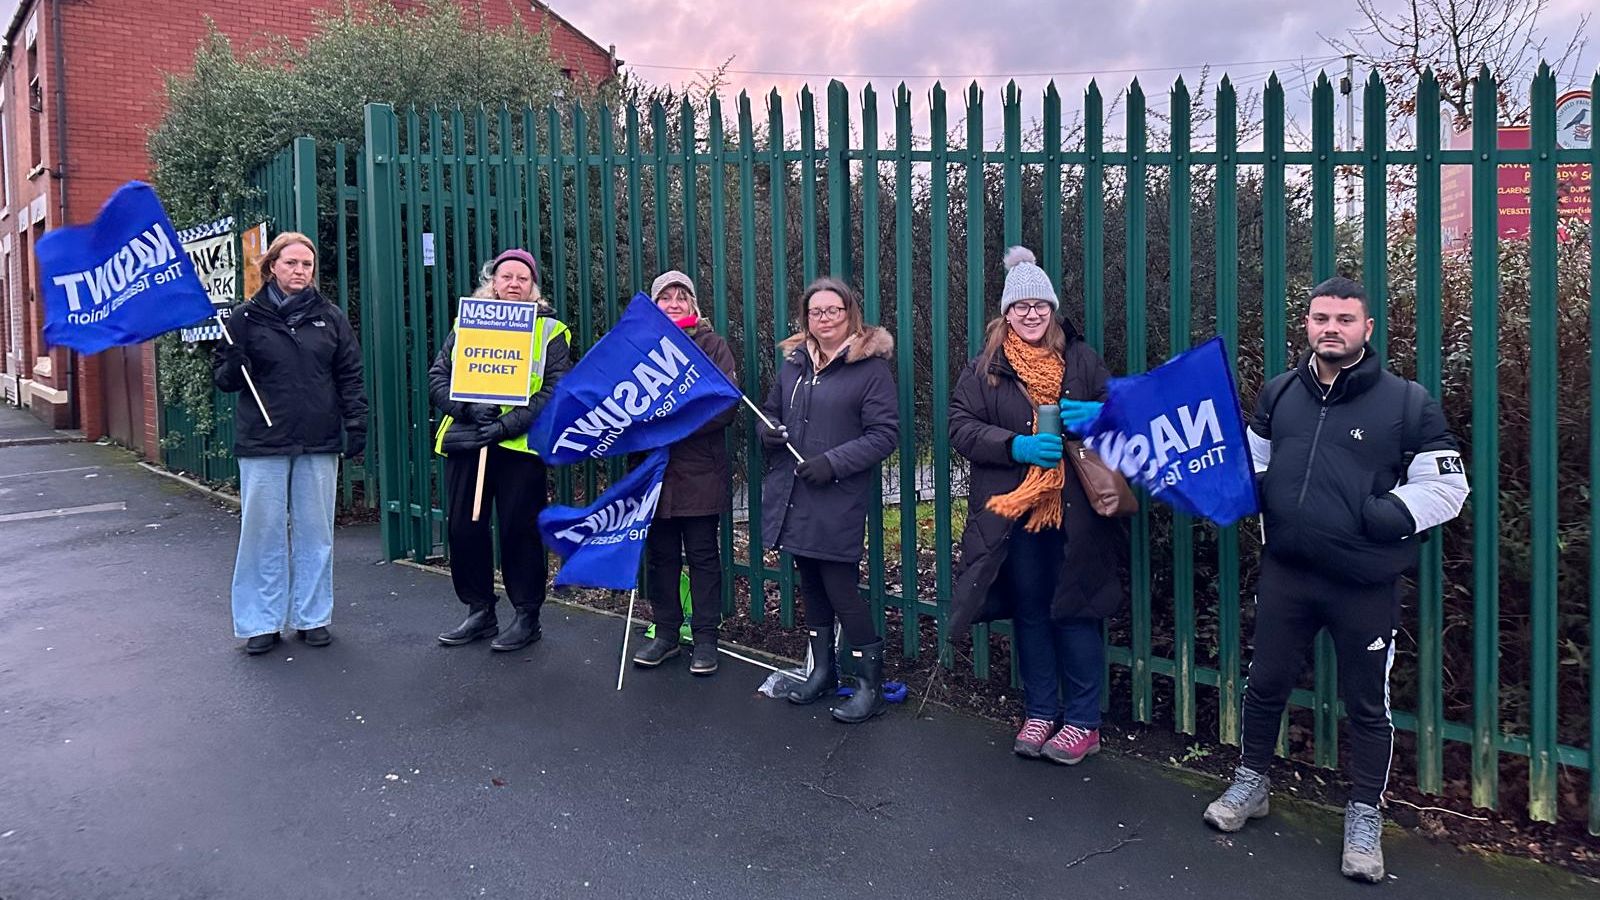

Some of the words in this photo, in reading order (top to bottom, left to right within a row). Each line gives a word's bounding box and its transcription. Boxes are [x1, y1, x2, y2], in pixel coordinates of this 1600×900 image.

[462, 302, 533, 322] NASUWT
[462, 317, 475, 325] The
[508, 321, 528, 329] Union
[464, 346, 524, 361] OFFICIAL
[468, 363, 517, 375] PICKET
